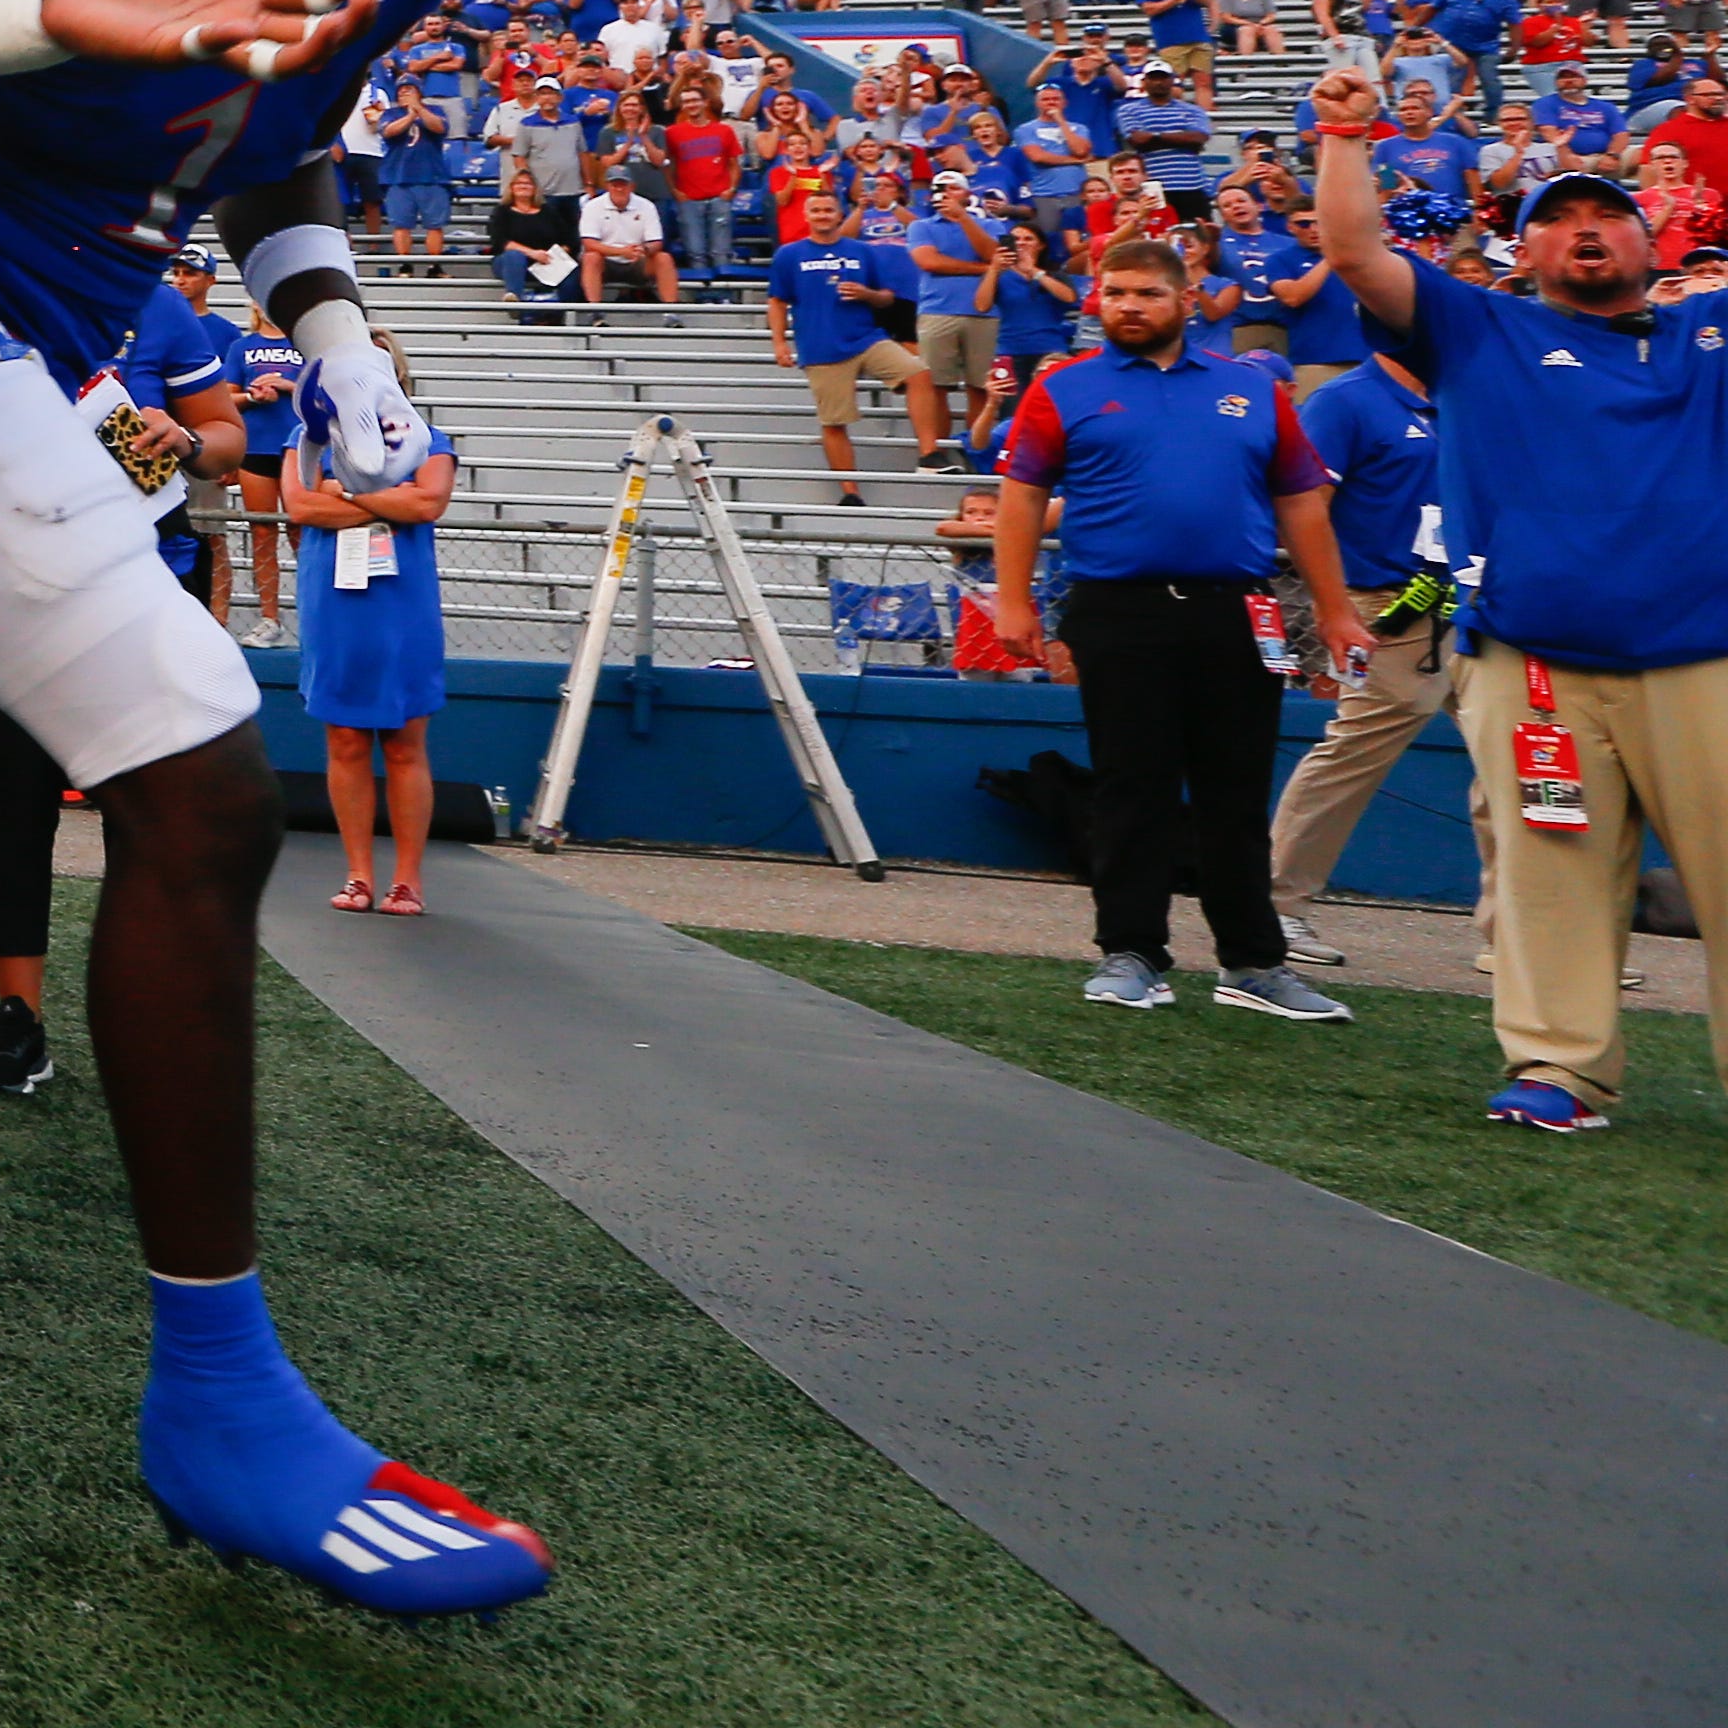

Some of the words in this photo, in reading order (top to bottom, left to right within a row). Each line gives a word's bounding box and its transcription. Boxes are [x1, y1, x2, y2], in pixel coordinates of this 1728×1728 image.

[407, 124, 421, 147] 9
[101, 78, 262, 252] 1
[244, 348, 304, 365] KANSAS
